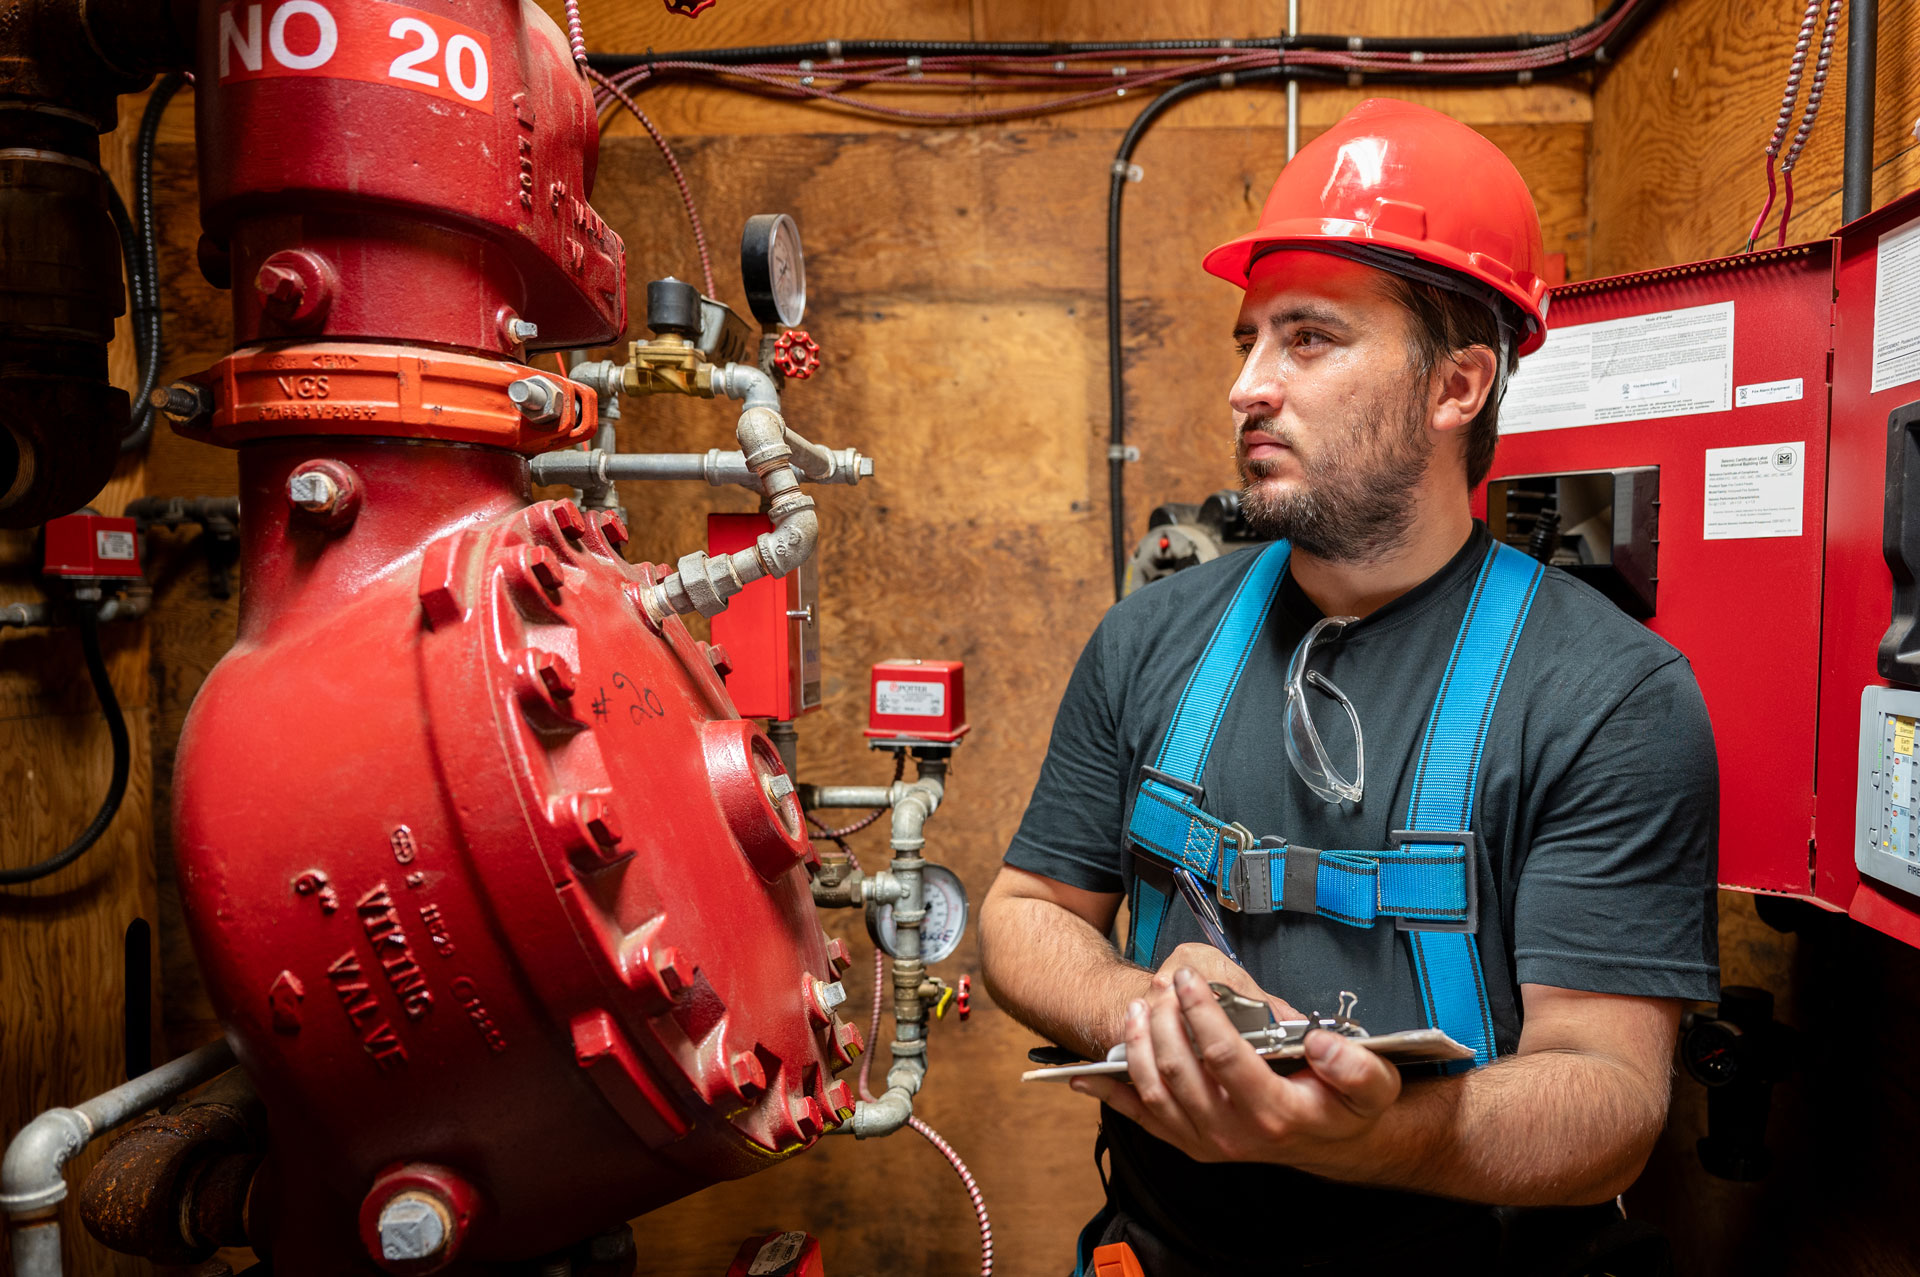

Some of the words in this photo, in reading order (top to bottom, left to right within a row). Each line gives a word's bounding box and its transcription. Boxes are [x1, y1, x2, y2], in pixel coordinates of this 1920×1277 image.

[219, 0, 338, 79] NO
[388, 17, 489, 102] 20
[356, 879, 434, 1018] VIKING
[328, 949, 409, 1068] VALVE
